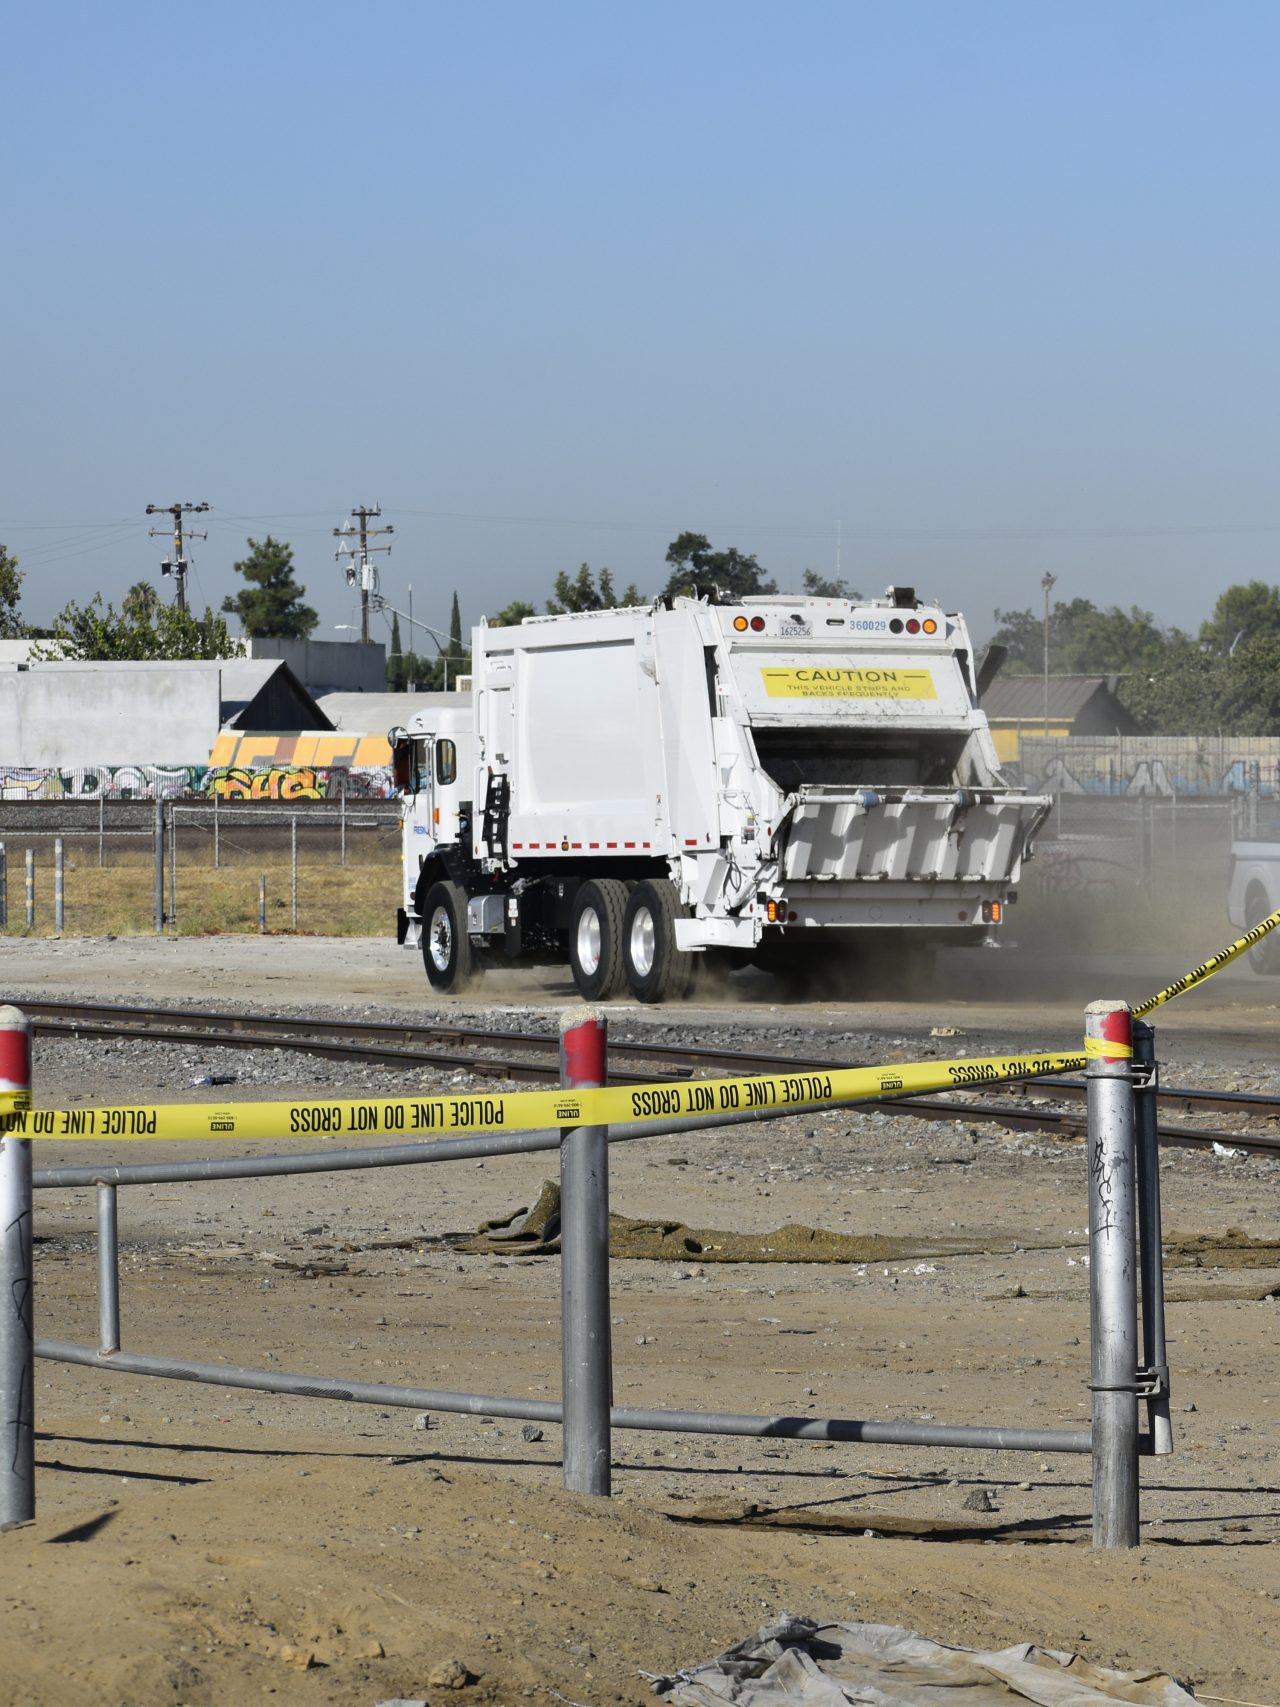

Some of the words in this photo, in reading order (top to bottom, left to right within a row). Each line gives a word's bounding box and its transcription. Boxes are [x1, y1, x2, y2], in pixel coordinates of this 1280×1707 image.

[780, 626, 811, 636] 1625256
[850, 620, 886, 631] 360029
[795, 669, 897, 682] CAUTION
[720, 1085, 739, 1108] DO
[744, 1081, 776, 1106] LINE
[782, 1076, 832, 1103] POLICE
[881, 1081, 903, 1090] ULINE
[631, 1089, 681, 1117] CROSS
[686, 1087, 714, 1112] NOT
[33, 1111, 55, 1134] DO
[61, 1110, 95, 1134] LINE
[101, 1110, 157, 1134] POLICE
[290, 1107, 341, 1132] CROSS
[347, 1106, 378, 1131] NOT
[385, 1105, 404, 1129] DO
[411, 1103, 443, 1128] LINE
[450, 1100, 504, 1127] POLICE
[557, 1109, 579, 1118] ULINE
[211, 1122, 234, 1131] ULINE
